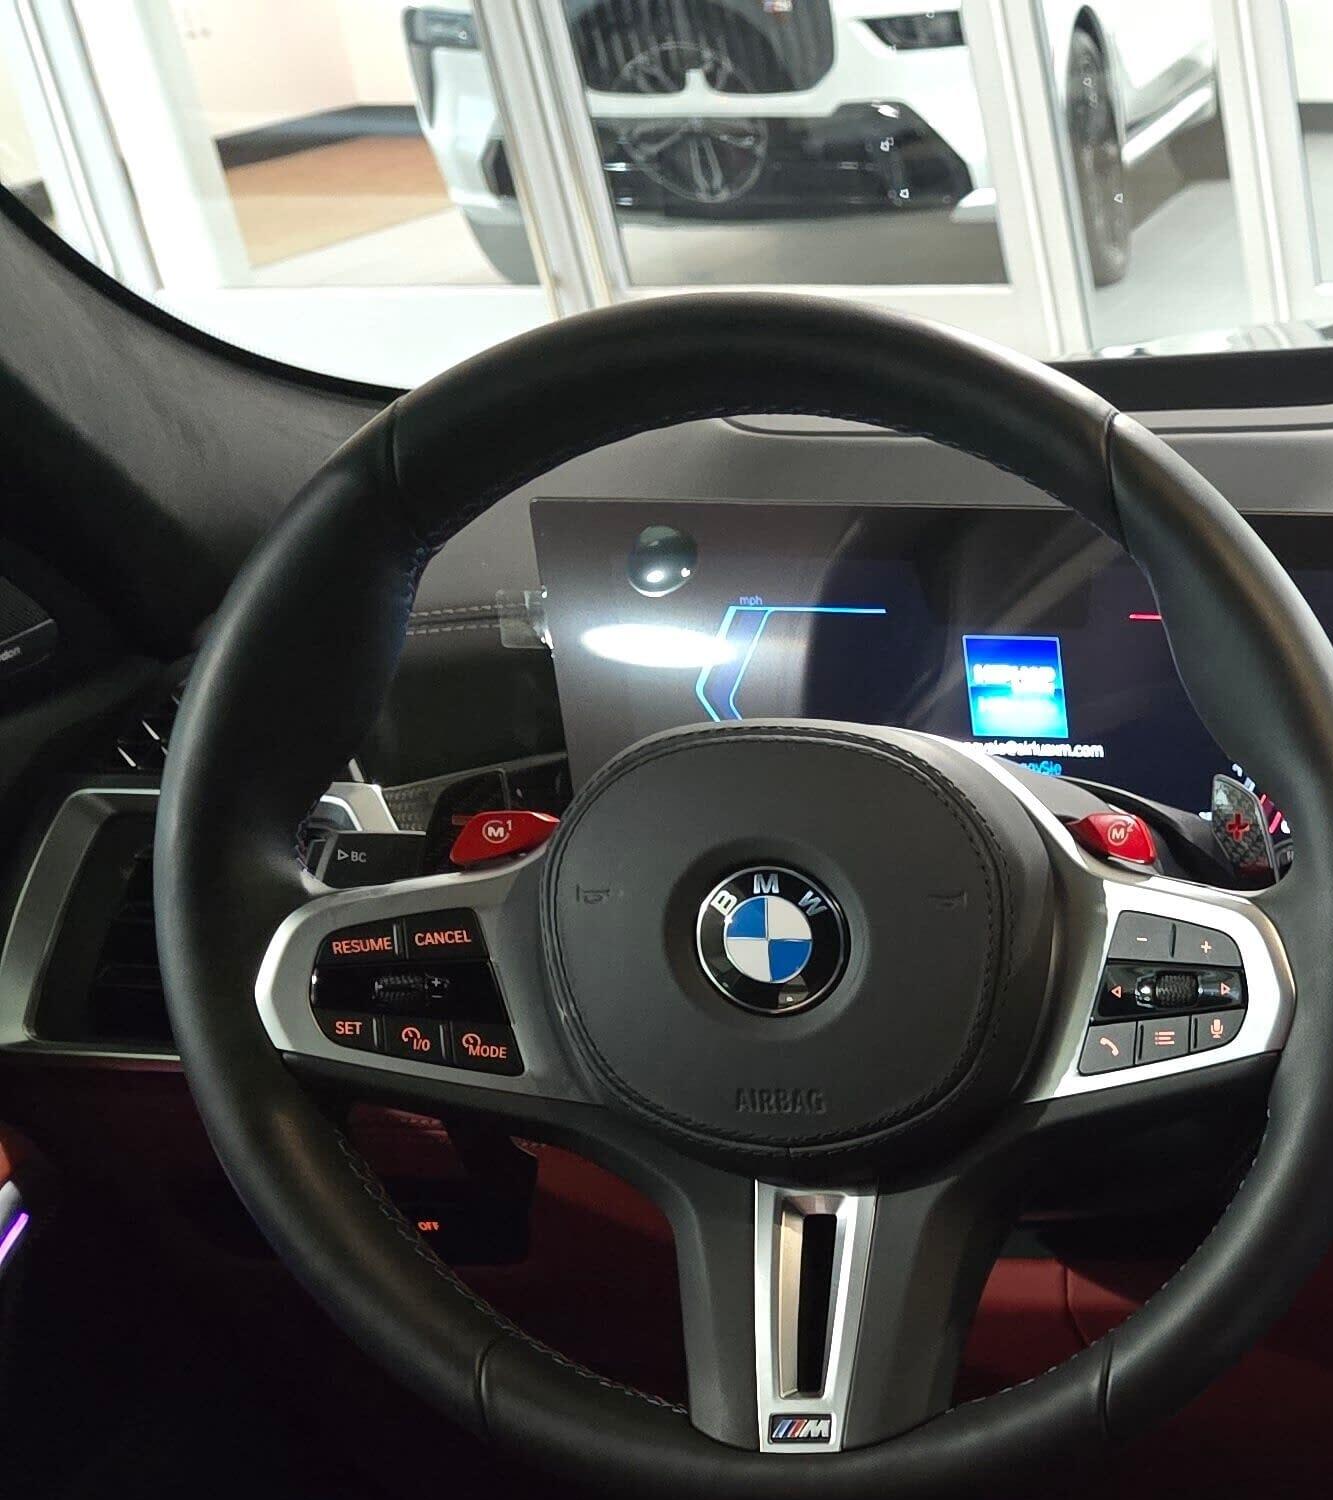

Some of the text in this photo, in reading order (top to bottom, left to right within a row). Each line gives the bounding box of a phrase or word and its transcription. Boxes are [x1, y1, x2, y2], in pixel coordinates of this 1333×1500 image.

[739, 595, 763, 606] mph
[351, 851, 367, 863] BC
[710, 873, 828, 917] BMW
[332, 936, 393, 955] RESUME
[414, 930, 472, 947] CANCEL
[335, 1021, 362, 1035] SET
[468, 1044, 507, 1060] MODE
[736, 1087, 827, 1115] AIRBAG
[417, 1221, 440, 1232] OFF
